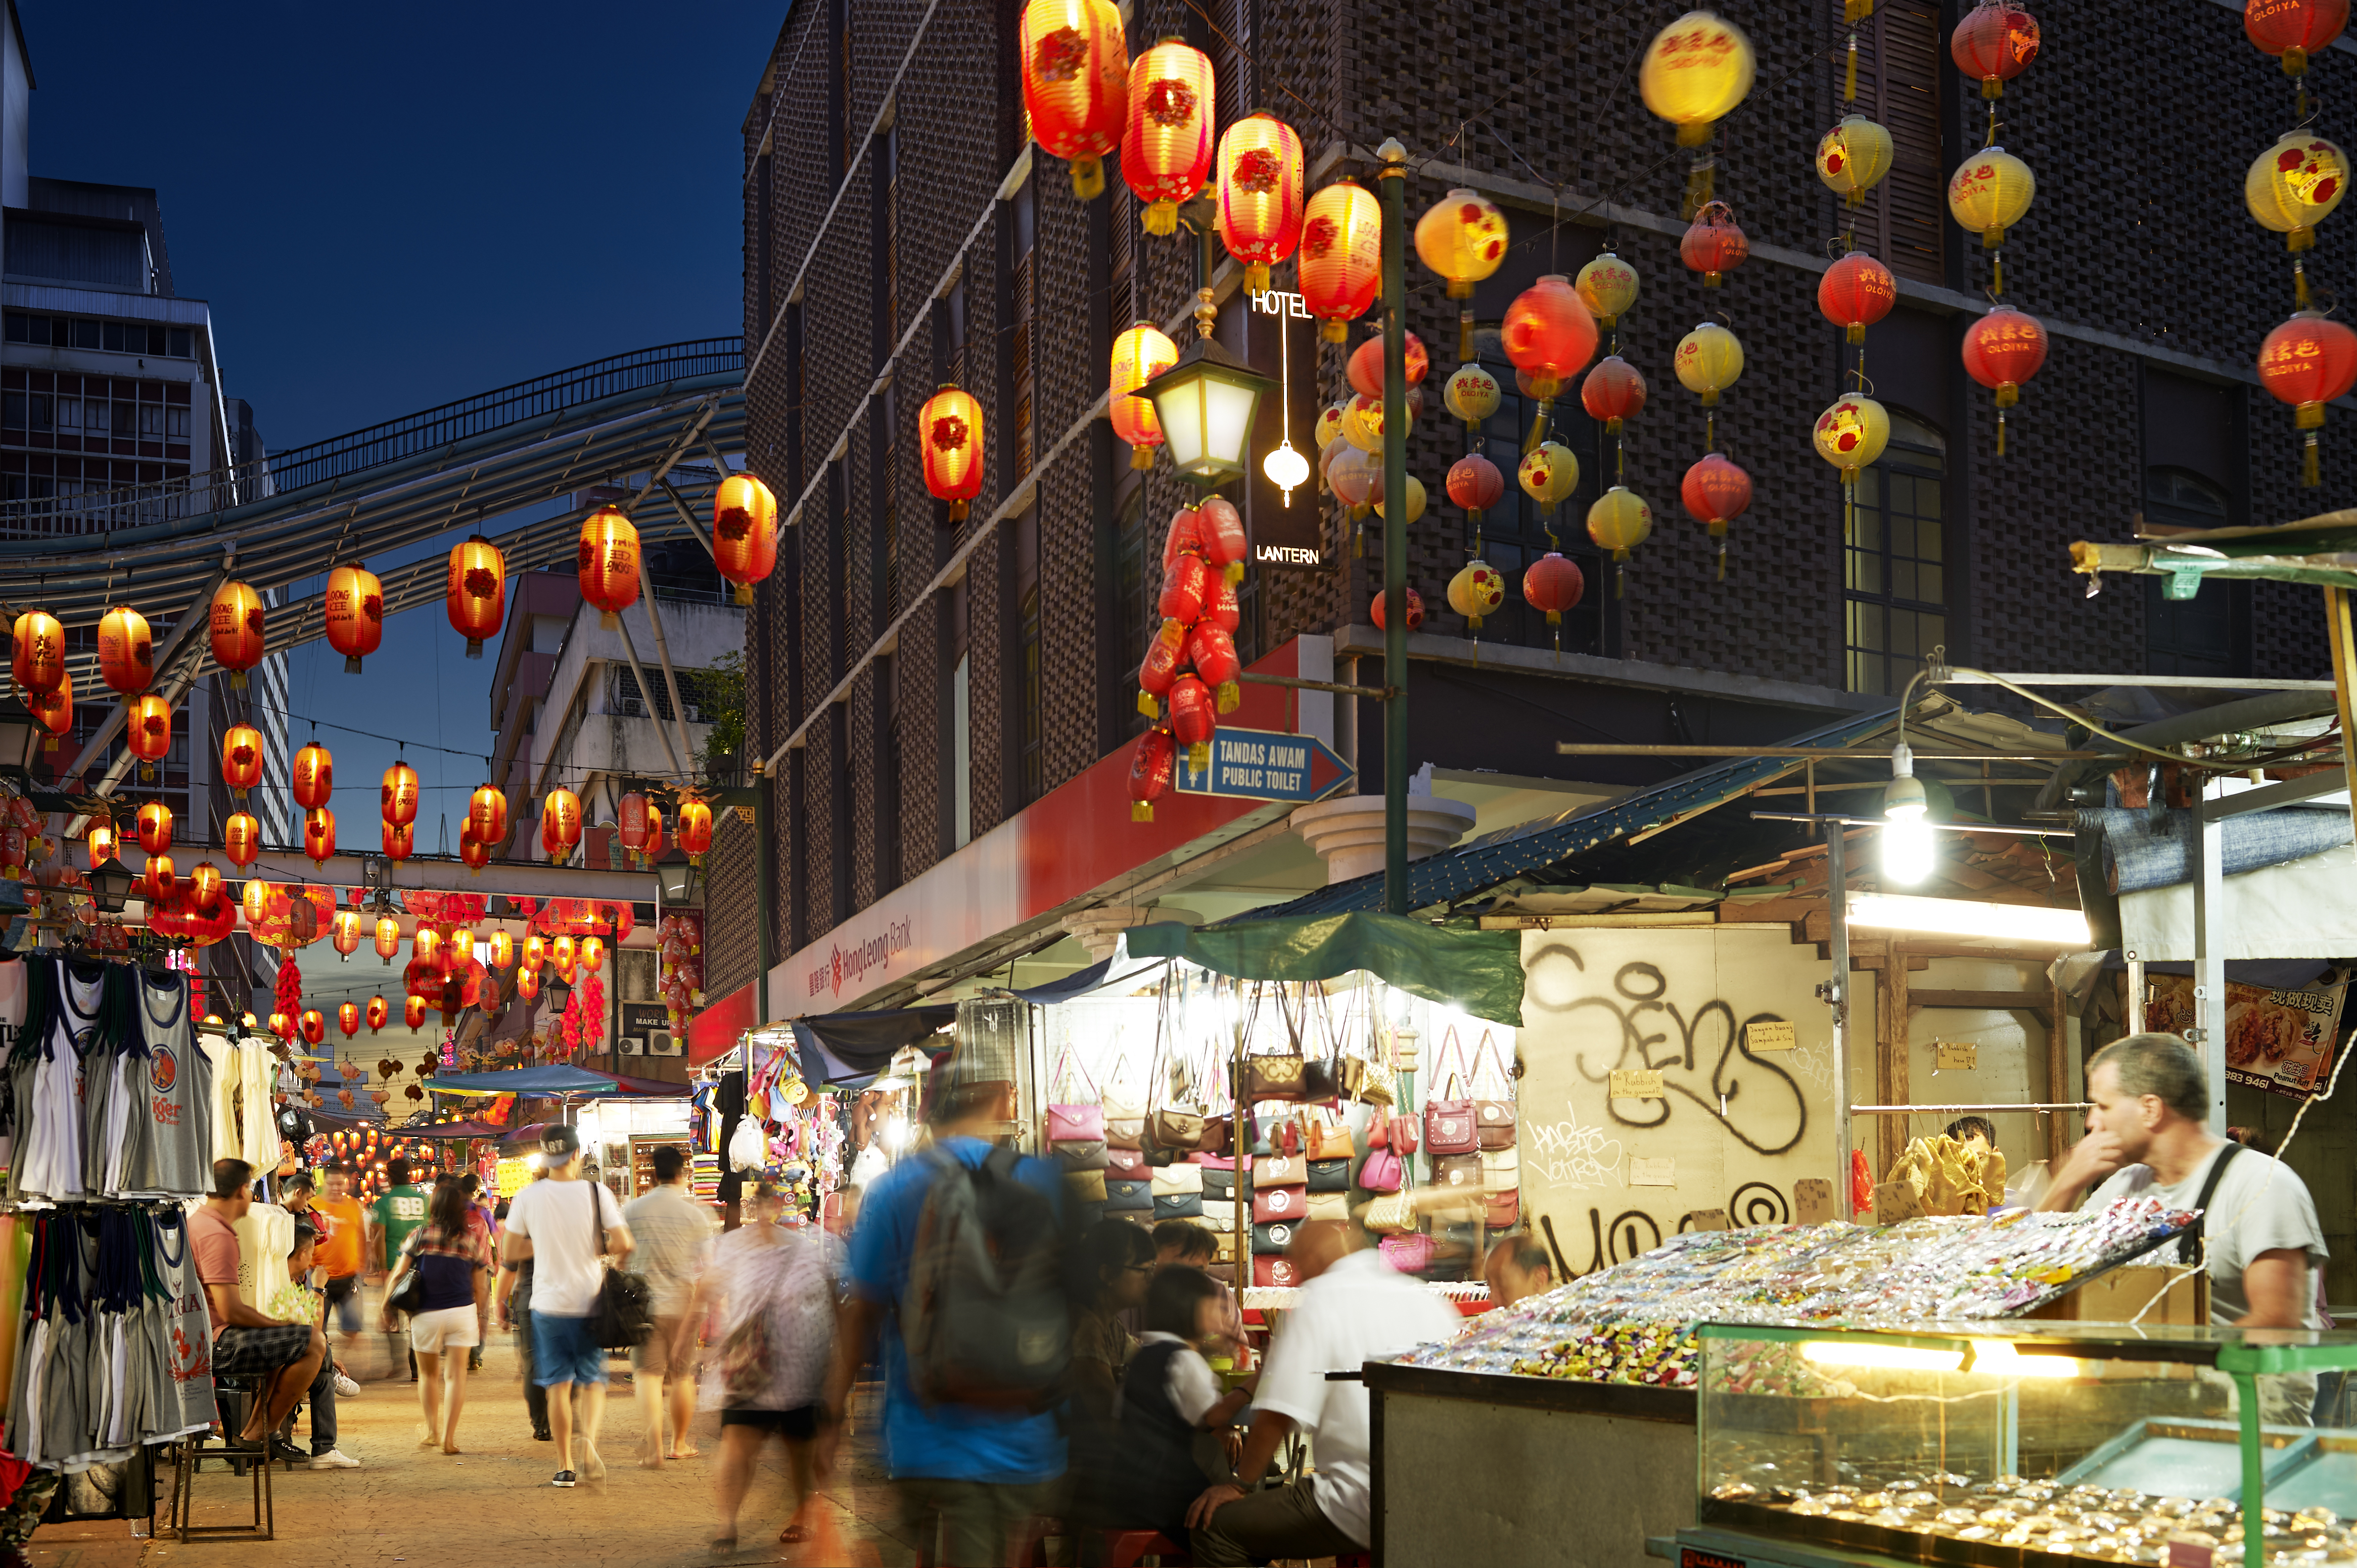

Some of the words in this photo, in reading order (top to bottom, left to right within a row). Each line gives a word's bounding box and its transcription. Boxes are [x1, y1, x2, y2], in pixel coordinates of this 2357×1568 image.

[2254, 1, 2300, 22] OLOIYA
[1866, 284, 1894, 301] OLOIYA
[1252, 288, 1313, 319] HOTEL
[1986, 343, 2030, 354] OLOIYA
[1257, 544, 1319, 564] LANTERN
[1220, 740, 1265, 766] TANDAS
[1268, 745, 1306, 769] AWAM
[1223, 766, 1263, 788] PUBLIC
[1266, 771, 1302, 792] TOILET
[890, 915, 912, 956] Bank
[2269, 989, 2334, 1017] 现做现卖
[639, 1008, 668, 1019] WORL
[636, 1018, 658, 1026] MAKE
[1750, 1026, 1773, 1036] Jangan
[1774, 1024, 1793, 1033] buang
[1750, 1035, 1775, 1046] Sampah
[1946, 1043, 1968, 1053] Rubbish
[2282, 1059, 2309, 1078] 花生角
[1624, 1071, 1657, 1087] Rubbish
[2244, 1076, 2269, 1090] 9461
[2274, 1072, 2297, 1084] Peanut
[2295, 1077, 2310, 1087] Puff
[151, 1096, 183, 1124] iger
[166, 1117, 180, 1126] Beer
